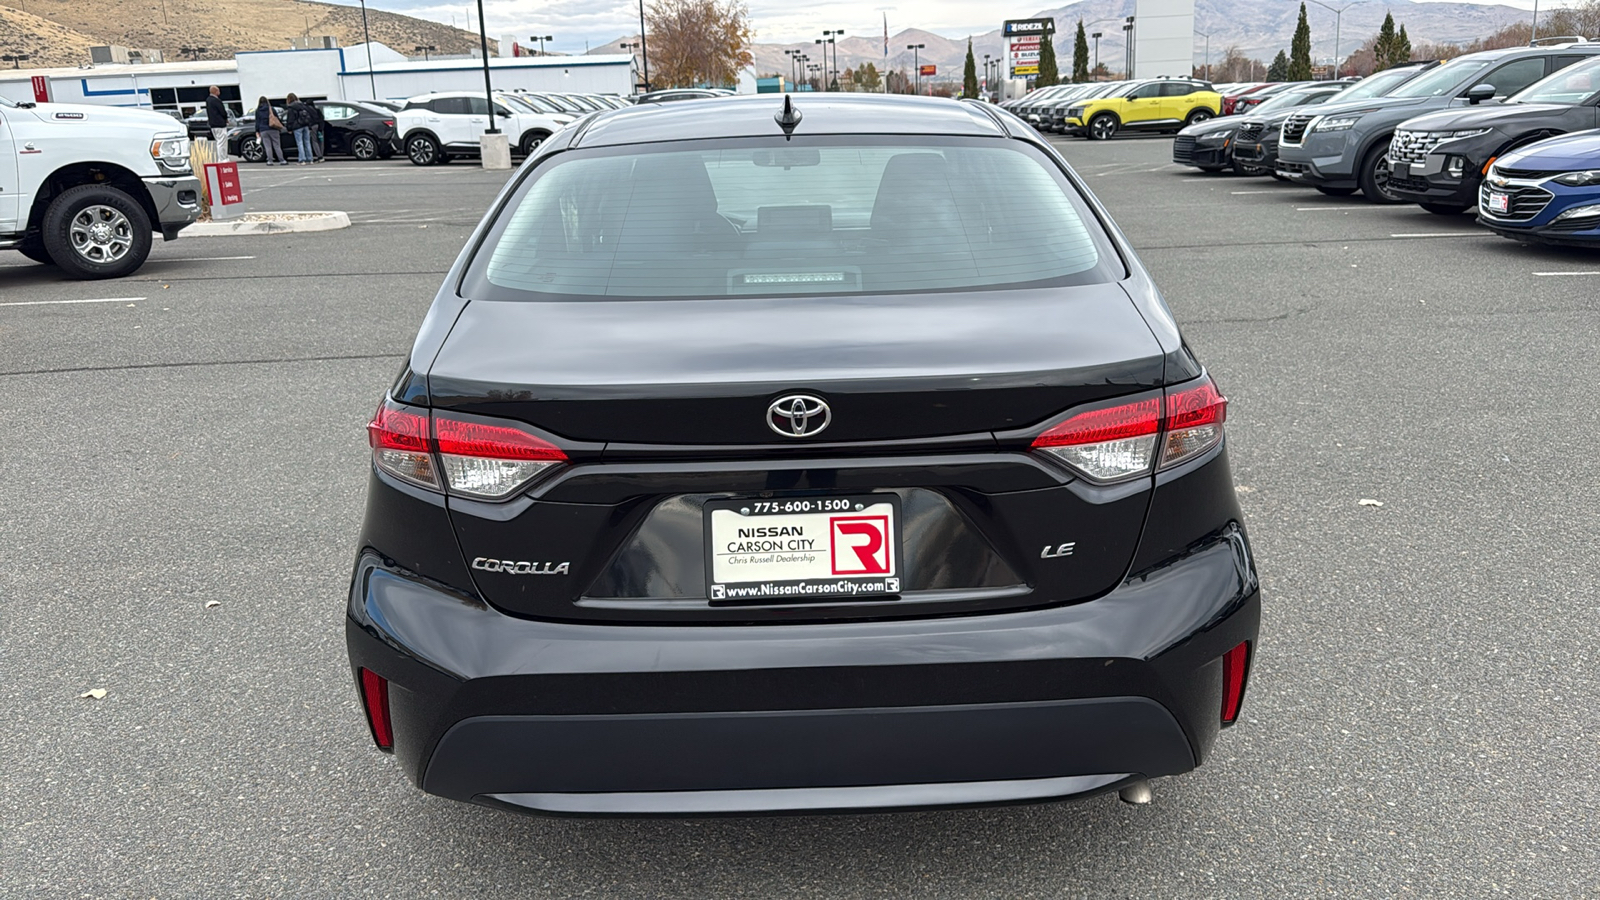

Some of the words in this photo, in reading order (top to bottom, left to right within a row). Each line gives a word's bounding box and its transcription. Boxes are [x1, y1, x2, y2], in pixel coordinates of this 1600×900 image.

[1017, 22, 1053, 31] RIDEZILA
[754, 500, 850, 512] 775-600-1500
[738, 526, 804, 538] NISSAN
[727, 540, 783, 553] CARSON
[787, 539, 815, 551] CITY
[1040, 542, 1076, 559] LE
[728, 556, 748, 565] Chris
[749, 555, 774, 564] Russell
[776, 553, 816, 563] Dealership
[472, 557, 570, 575] COROLLA
[727, 581, 884, 597] www.NissanCarsonCity.com
